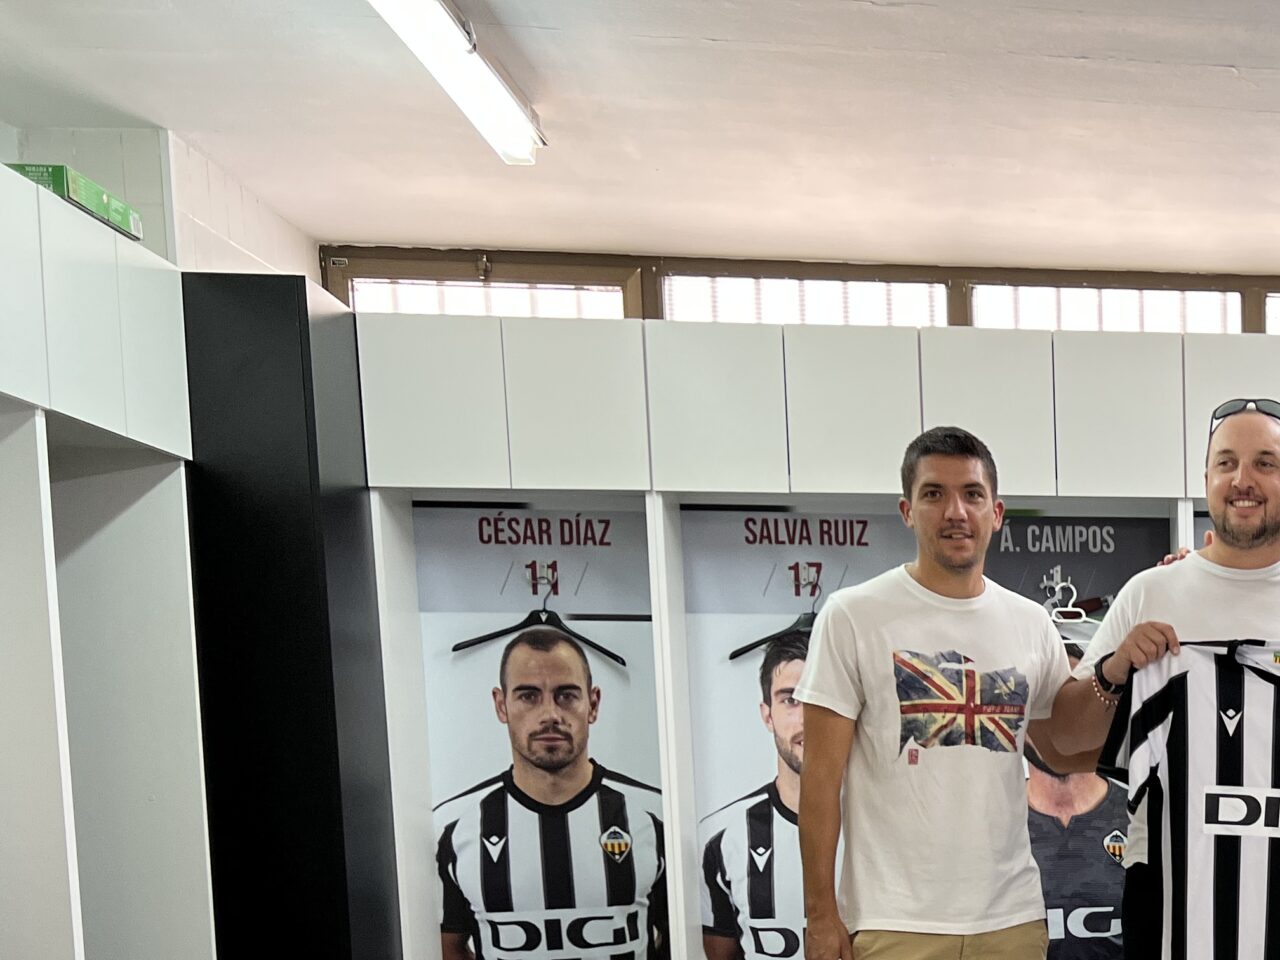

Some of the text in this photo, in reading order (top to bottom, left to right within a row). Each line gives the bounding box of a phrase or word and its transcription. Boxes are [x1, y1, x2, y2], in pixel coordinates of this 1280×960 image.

[478, 511, 612, 546] CÉSAR DÍAZ
[744, 517, 869, 547] SALVA RUIZ
[1000, 519, 1115, 553] Á. CAMPOS
[525, 560, 559, 596] 11
[788, 561, 822, 597] 17
[486, 910, 640, 951] DIGI
[749, 926, 808, 958] D
